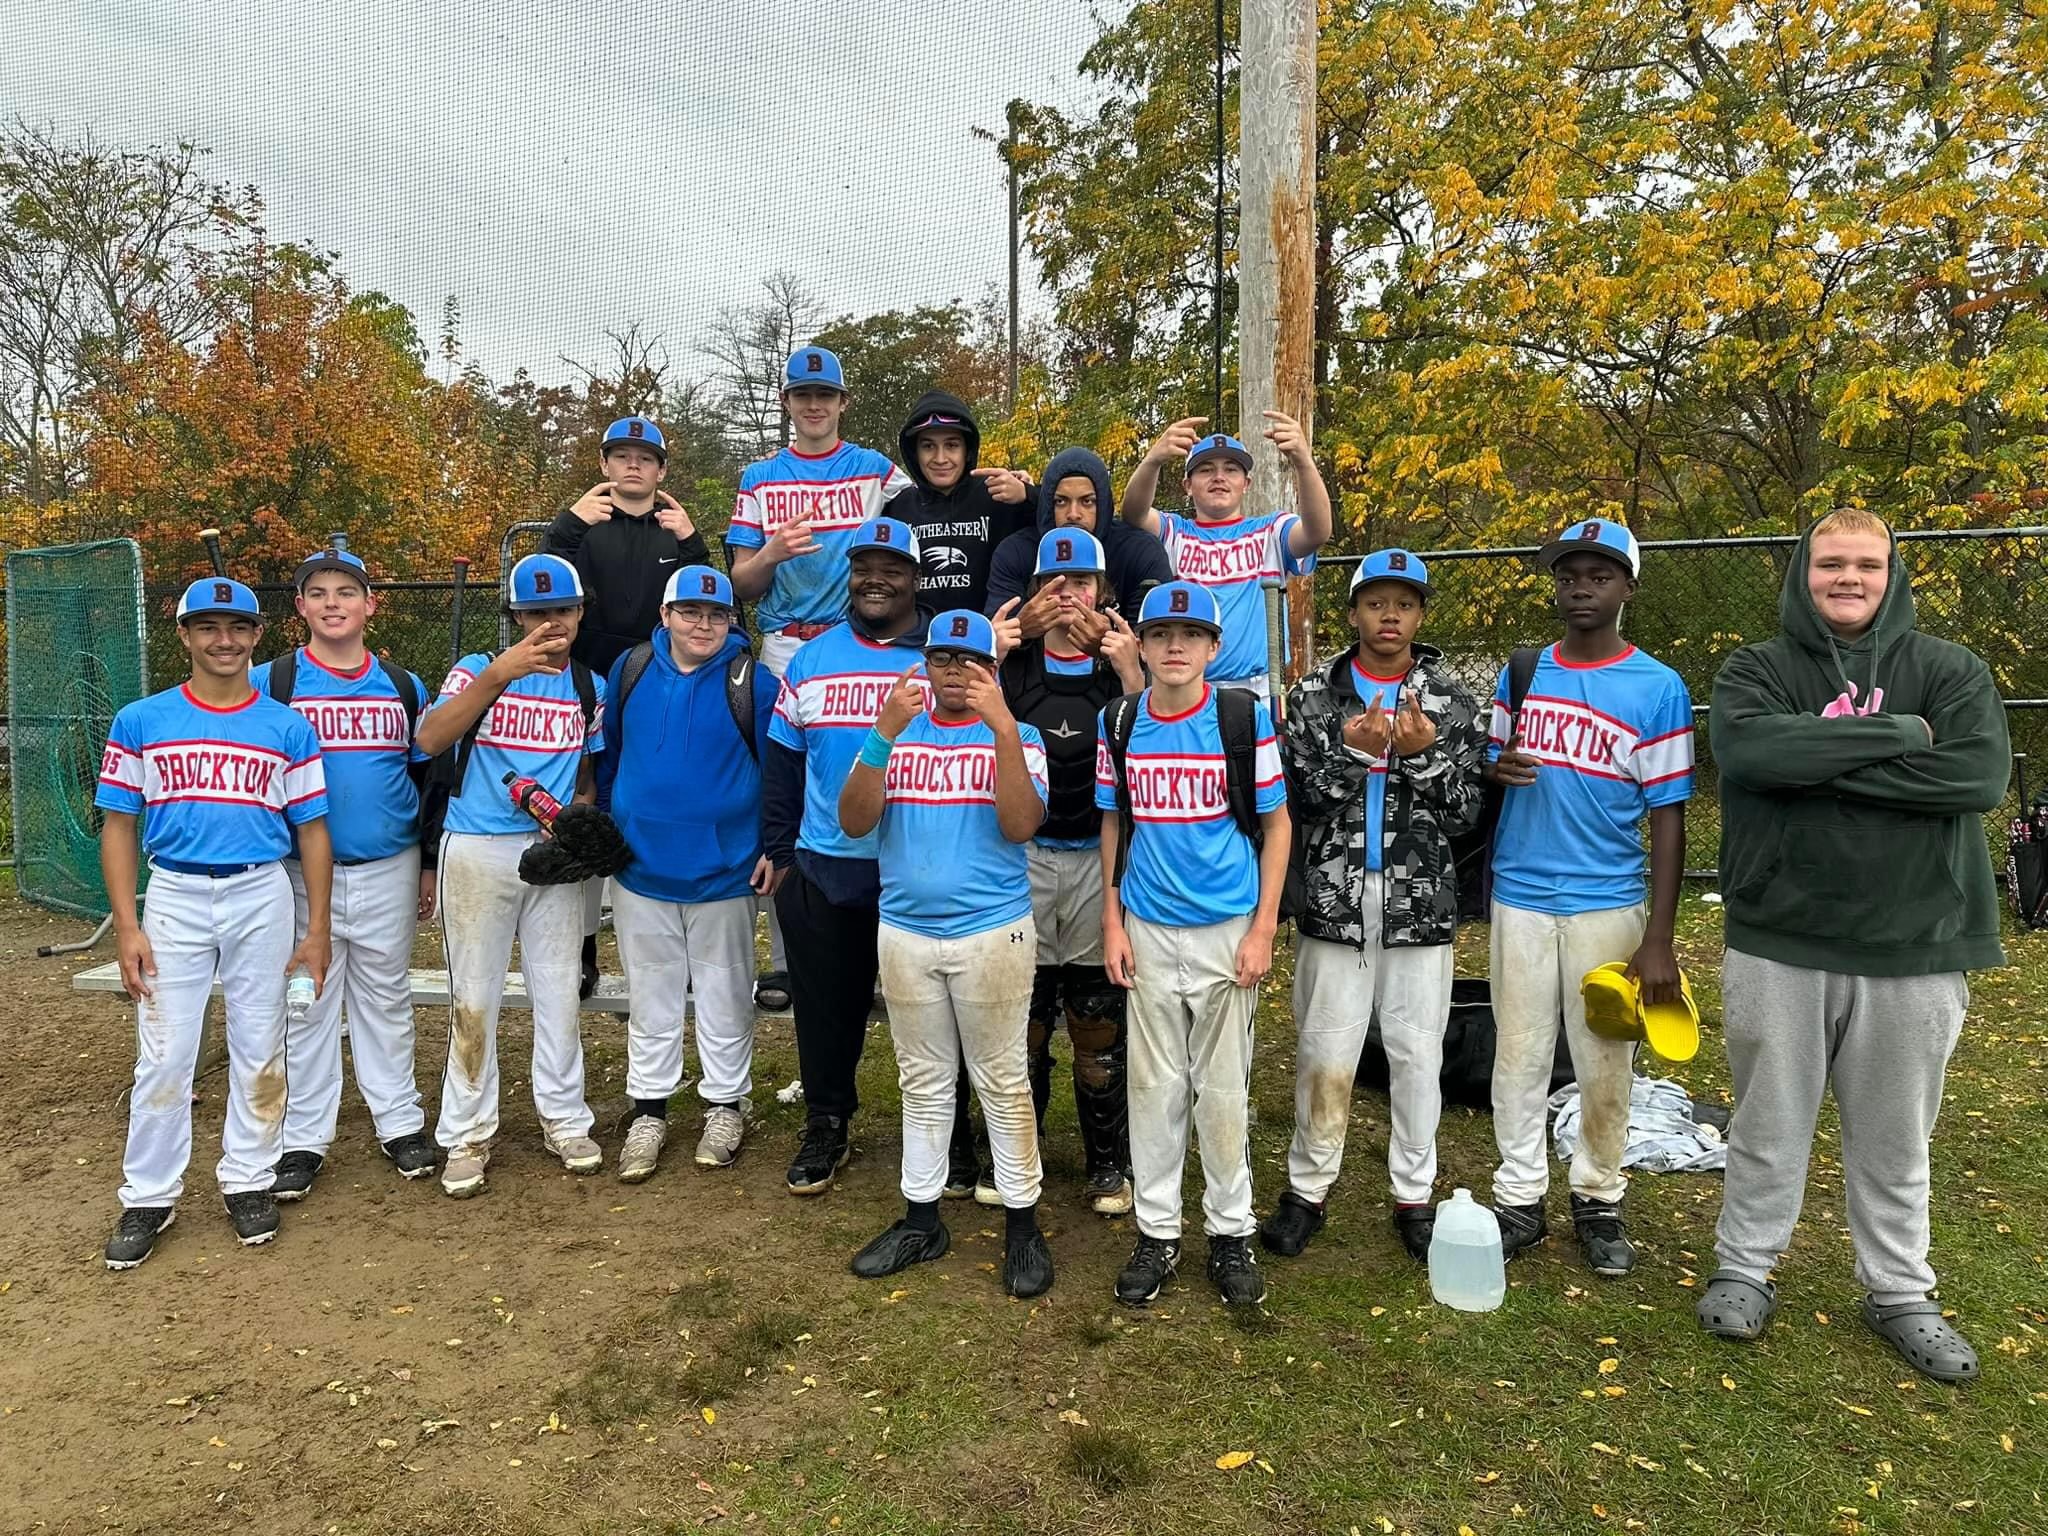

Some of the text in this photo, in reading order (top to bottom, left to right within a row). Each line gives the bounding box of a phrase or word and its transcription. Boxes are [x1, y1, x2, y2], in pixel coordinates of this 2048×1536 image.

[806, 353, 823, 372] B
[628, 421, 644, 437] B
[1212, 436, 1227, 448] B
[765, 486, 864, 525] BROCKTON
[874, 524, 891, 543] B
[1579, 522, 1600, 540] B
[1055, 539, 1073, 562] B
[1178, 538, 1266, 577] BROCKTON
[1388, 552, 1407, 570] B
[214, 582, 232, 603] B
[534, 572, 552, 593] B
[701, 574, 717, 594] B
[919, 574, 971, 590] HAWKS
[1169, 589, 1190, 613] B
[950, 616, 969, 637] B
[822, 682, 934, 716] BROCKN
[1516, 707, 1620, 765] ROCKTON
[154, 752, 277, 797] BROCKTON
[1126, 766, 1228, 810] ROCKTON
